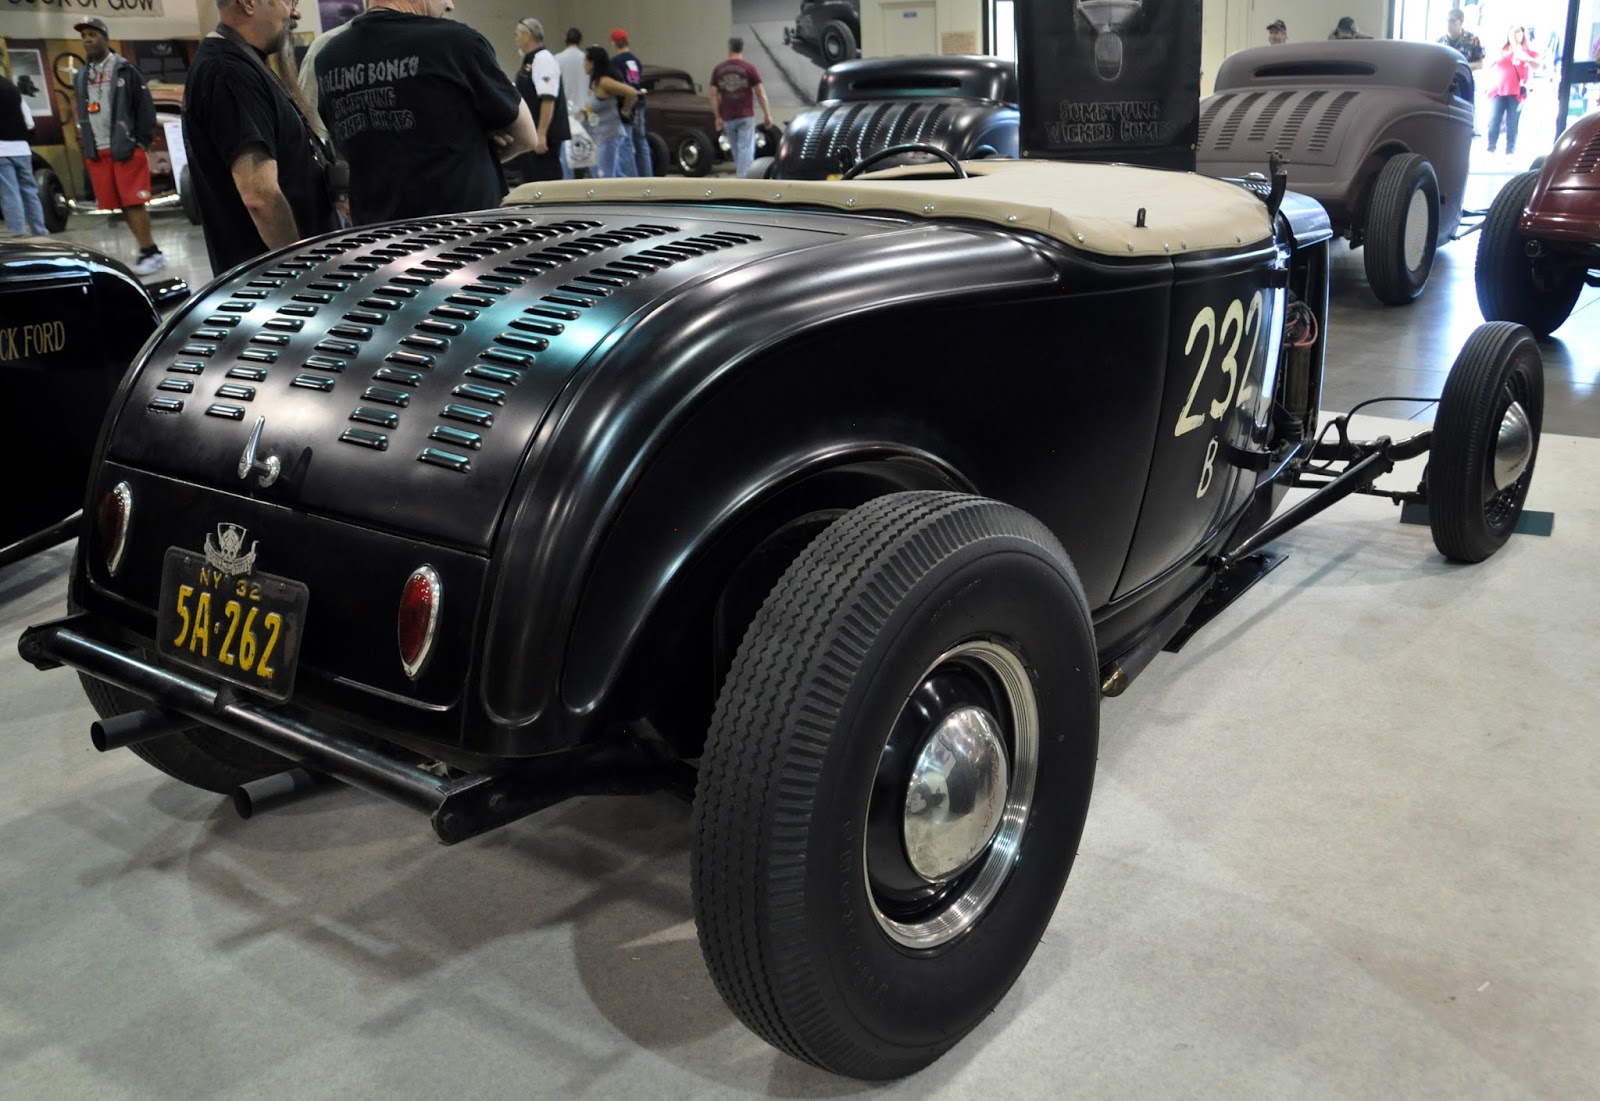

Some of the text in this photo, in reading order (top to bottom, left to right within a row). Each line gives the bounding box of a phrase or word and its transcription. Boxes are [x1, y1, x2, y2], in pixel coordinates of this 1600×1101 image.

[368, 55, 419, 85] BONES
[1059, 99, 1160, 122] SOMETHING
[1044, 120, 1114, 144] WICKED
[23, 320, 66, 357] FORD
[1174, 290, 1262, 437] 232
[1196, 435, 1219, 498] B
[199, 567, 262, 601] NY 32
